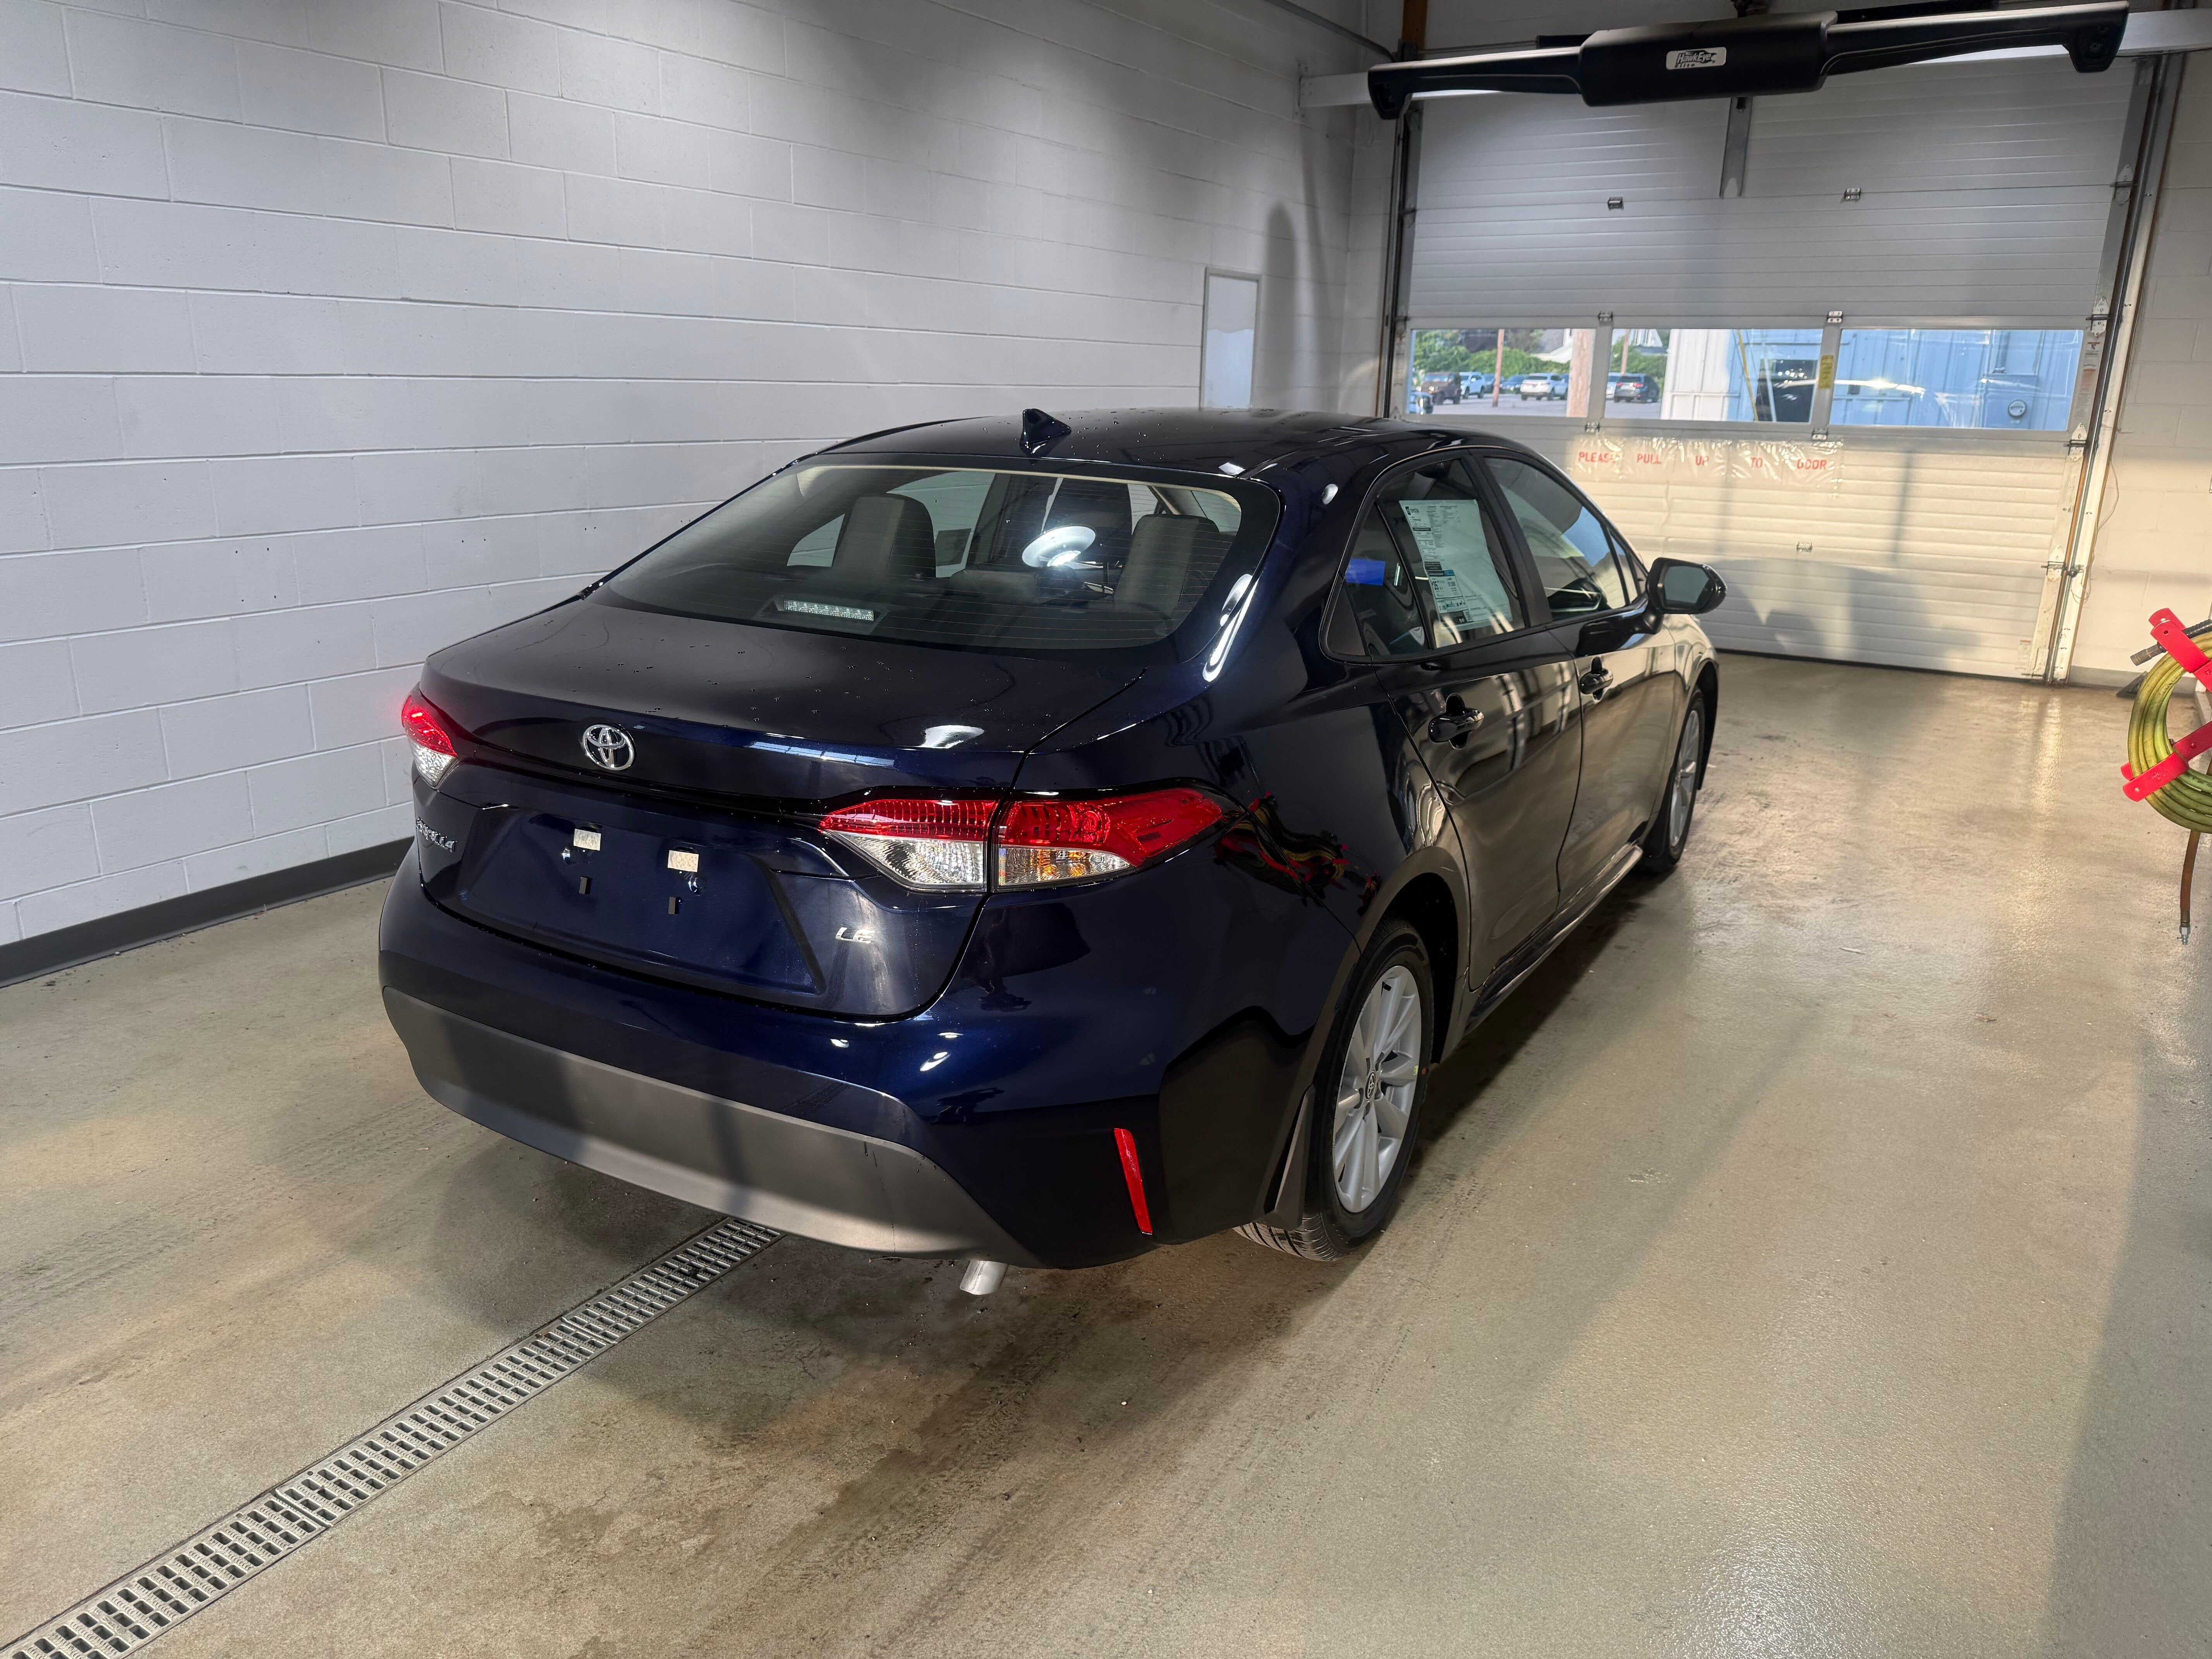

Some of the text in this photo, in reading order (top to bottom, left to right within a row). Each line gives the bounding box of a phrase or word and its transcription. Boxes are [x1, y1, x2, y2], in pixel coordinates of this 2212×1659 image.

[1637, 453, 1662, 465] PULL
[1695, 455, 1709, 466] UP
[1750, 457, 1763, 468] TO
[835, 927, 875, 944] LE
